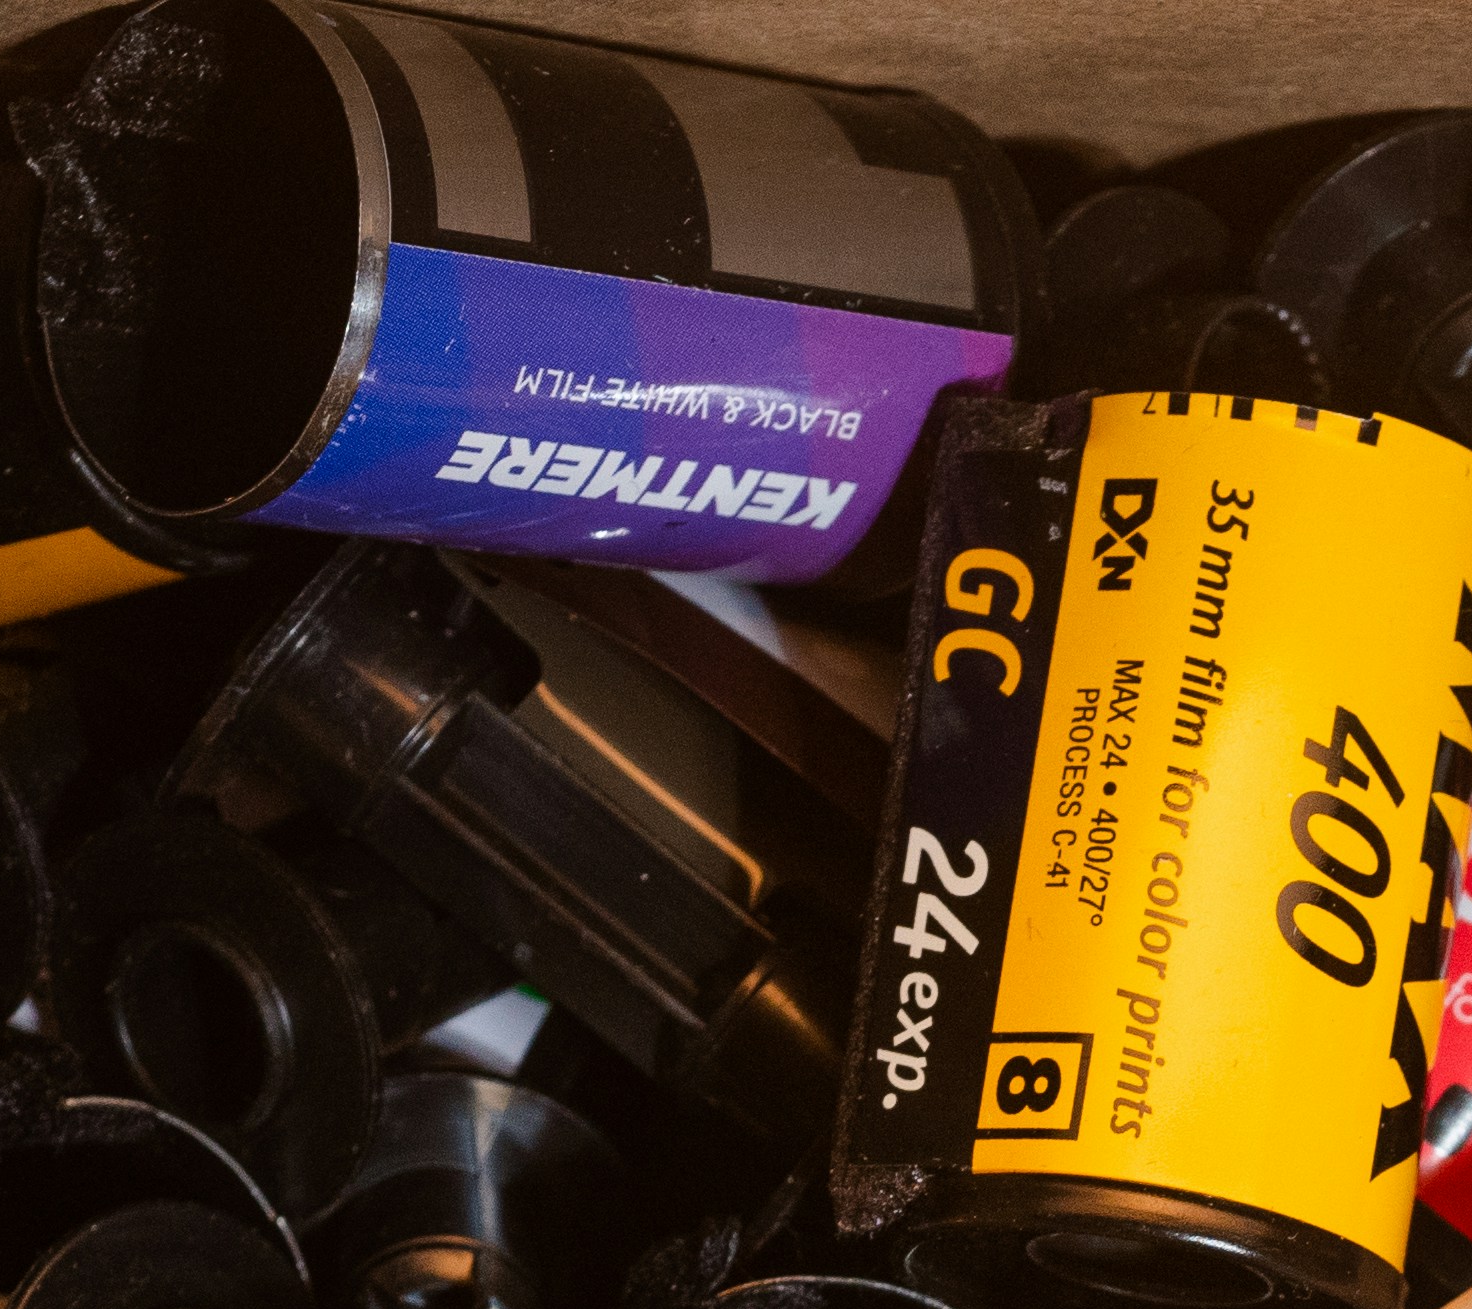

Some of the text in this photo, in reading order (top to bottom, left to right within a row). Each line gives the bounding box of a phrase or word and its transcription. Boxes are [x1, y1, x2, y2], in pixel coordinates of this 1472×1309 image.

[513, 364, 862, 441] BLACK & WHITE FILM
[433, 430, 861, 531] KENTMERE
[1106, 659, 1145, 724] MAX
[1171, 655, 1228, 749] film
[1044, 687, 1101, 889] PROCESS C-41
[1099, 733, 1132, 770] 24
[875, 547, 1035, 1111] GC 24 exp.
[1158, 764, 1210, 840] for
[1275, 704, 1406, 988] 400
[1136, 851, 1188, 979] color
[994, 1055, 1062, 1116] 8
[1110, 987, 1167, 1139] prints
